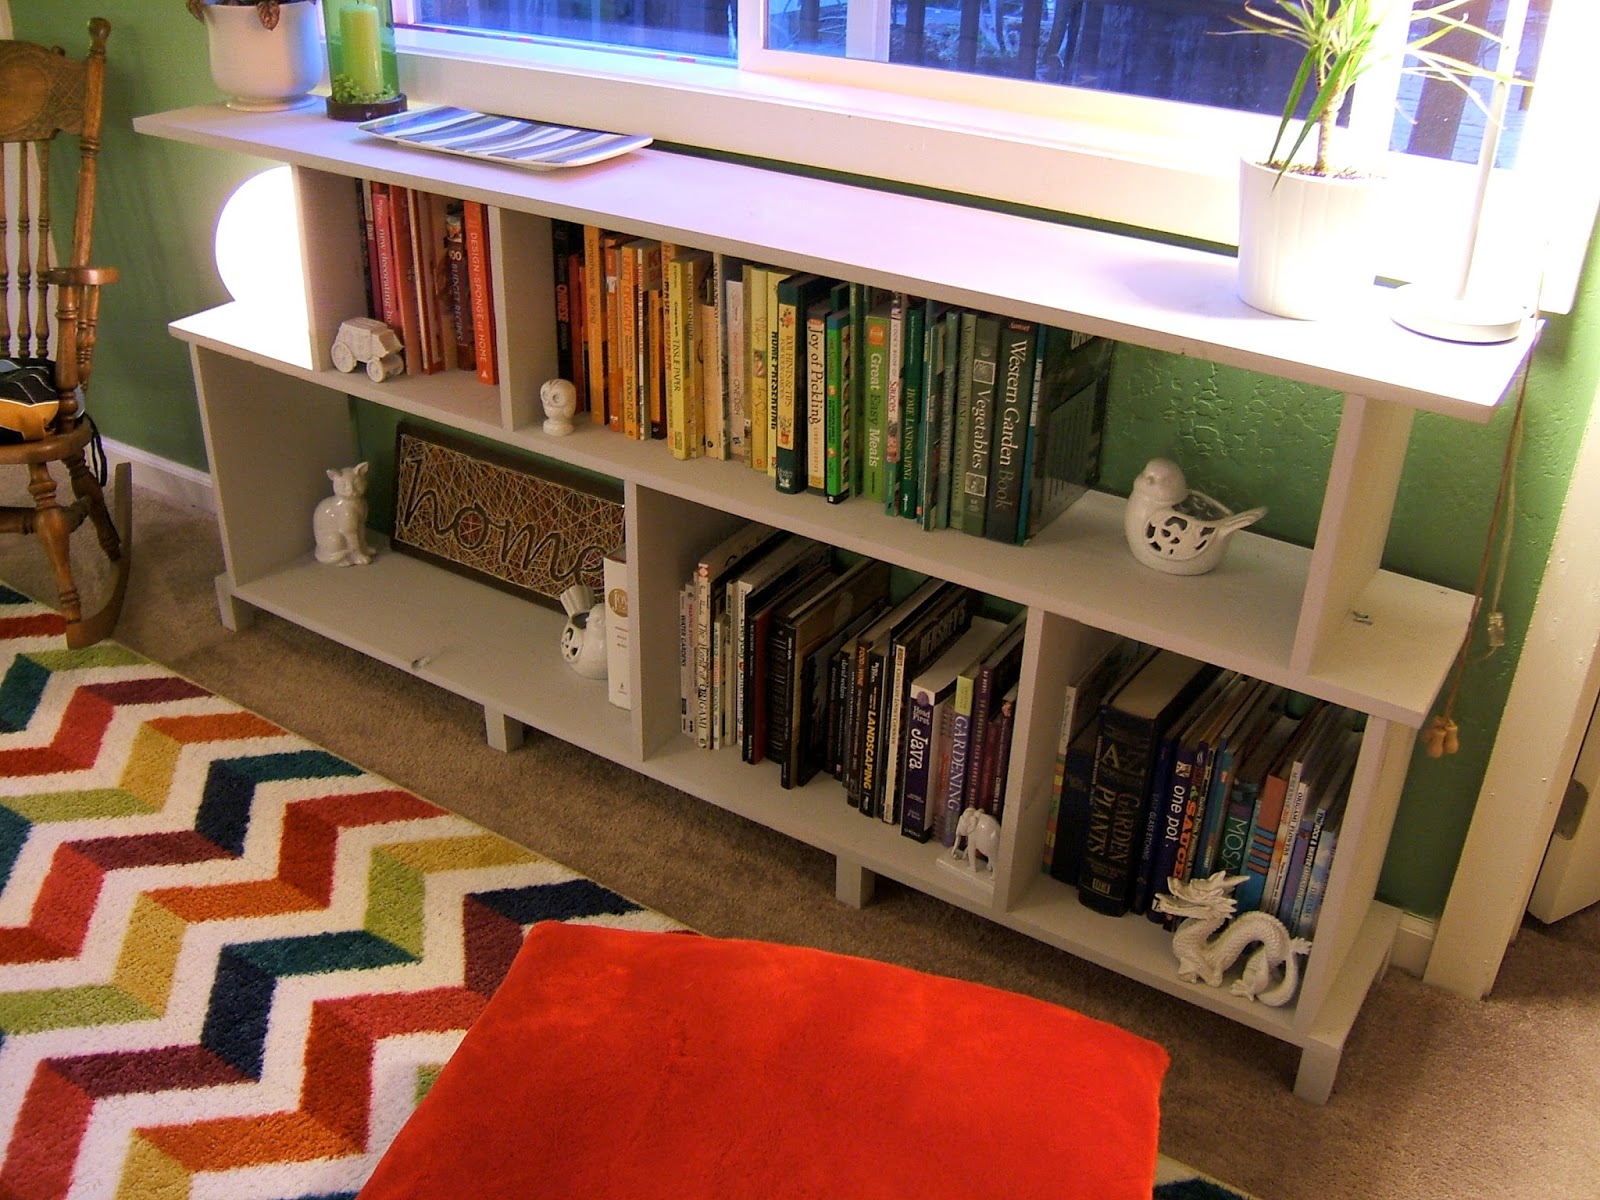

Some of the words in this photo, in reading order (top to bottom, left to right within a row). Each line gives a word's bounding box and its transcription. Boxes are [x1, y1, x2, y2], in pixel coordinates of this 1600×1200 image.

[380, 252, 393, 308] decorating
[478, 333, 488, 362] HOME
[770, 331, 779, 361] HOME
[808, 326, 824, 350] Joy
[785, 353, 793, 379] HINTS
[810, 357, 823, 367] of
[869, 353, 882, 390] Great
[1005, 339, 1028, 404] Western
[770, 364, 779, 429] PRESERVING
[785, 389, 793, 407] TIPS
[807, 367, 824, 425] Pickling
[867, 394, 882, 426] Easy
[888, 380, 899, 413] Sauces
[906, 388, 916, 415] HOME
[868, 428, 881, 467] Meals
[971, 389, 991, 469] Vegetables
[999, 407, 1020, 466] Garden
[902, 418, 914, 480] LANDSCAPING
[995, 469, 1015, 509] Book
[399, 458, 608, 587] home
[698, 622, 708, 639] The
[697, 643, 708, 668] World
[697, 684, 708, 730] ORIGAMI
[862, 709, 877, 791] LANDSCAPING
[908, 727, 928, 770] Java
[947, 715, 969, 812] GARDENING
[1170, 784, 1187, 815] one
[1291, 792, 1304, 823] ORIGAMI
[1088, 784, 1117, 857] PLANTS
[1107, 792, 1141, 866] GARDEN
[1311, 823, 1321, 841] ROCK
[1283, 825, 1297, 856] FLOWERS
[1304, 845, 1318, 867] WATER
